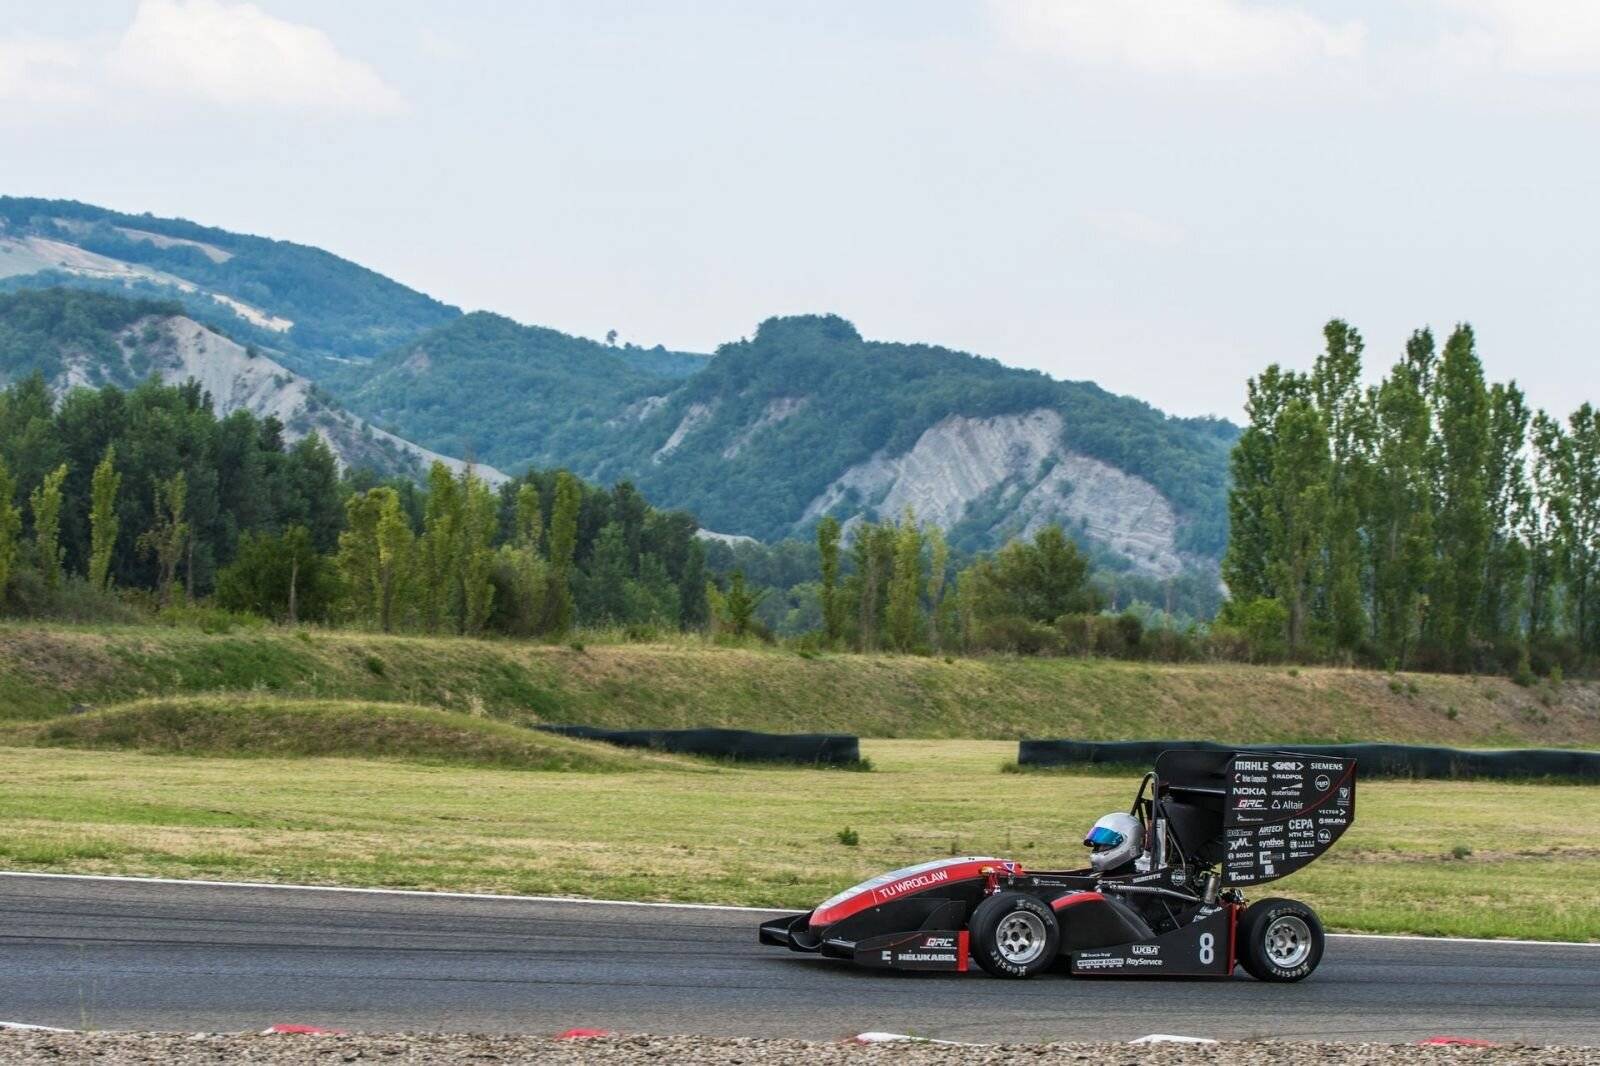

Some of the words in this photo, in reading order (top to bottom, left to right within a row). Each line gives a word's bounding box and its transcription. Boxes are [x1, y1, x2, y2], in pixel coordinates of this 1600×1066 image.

[1235, 761, 1269, 771] MAHLE
[1233, 787, 1267, 795] NOKIA
[1282, 801, 1304, 809] Altair
[1288, 819, 1313, 830] CEPA
[879, 886, 896, 898] TU
[1199, 932, 1215, 965] 8
[898, 953, 957, 962] HELUKABEL
[1126, 958, 1163, 967] RayService
